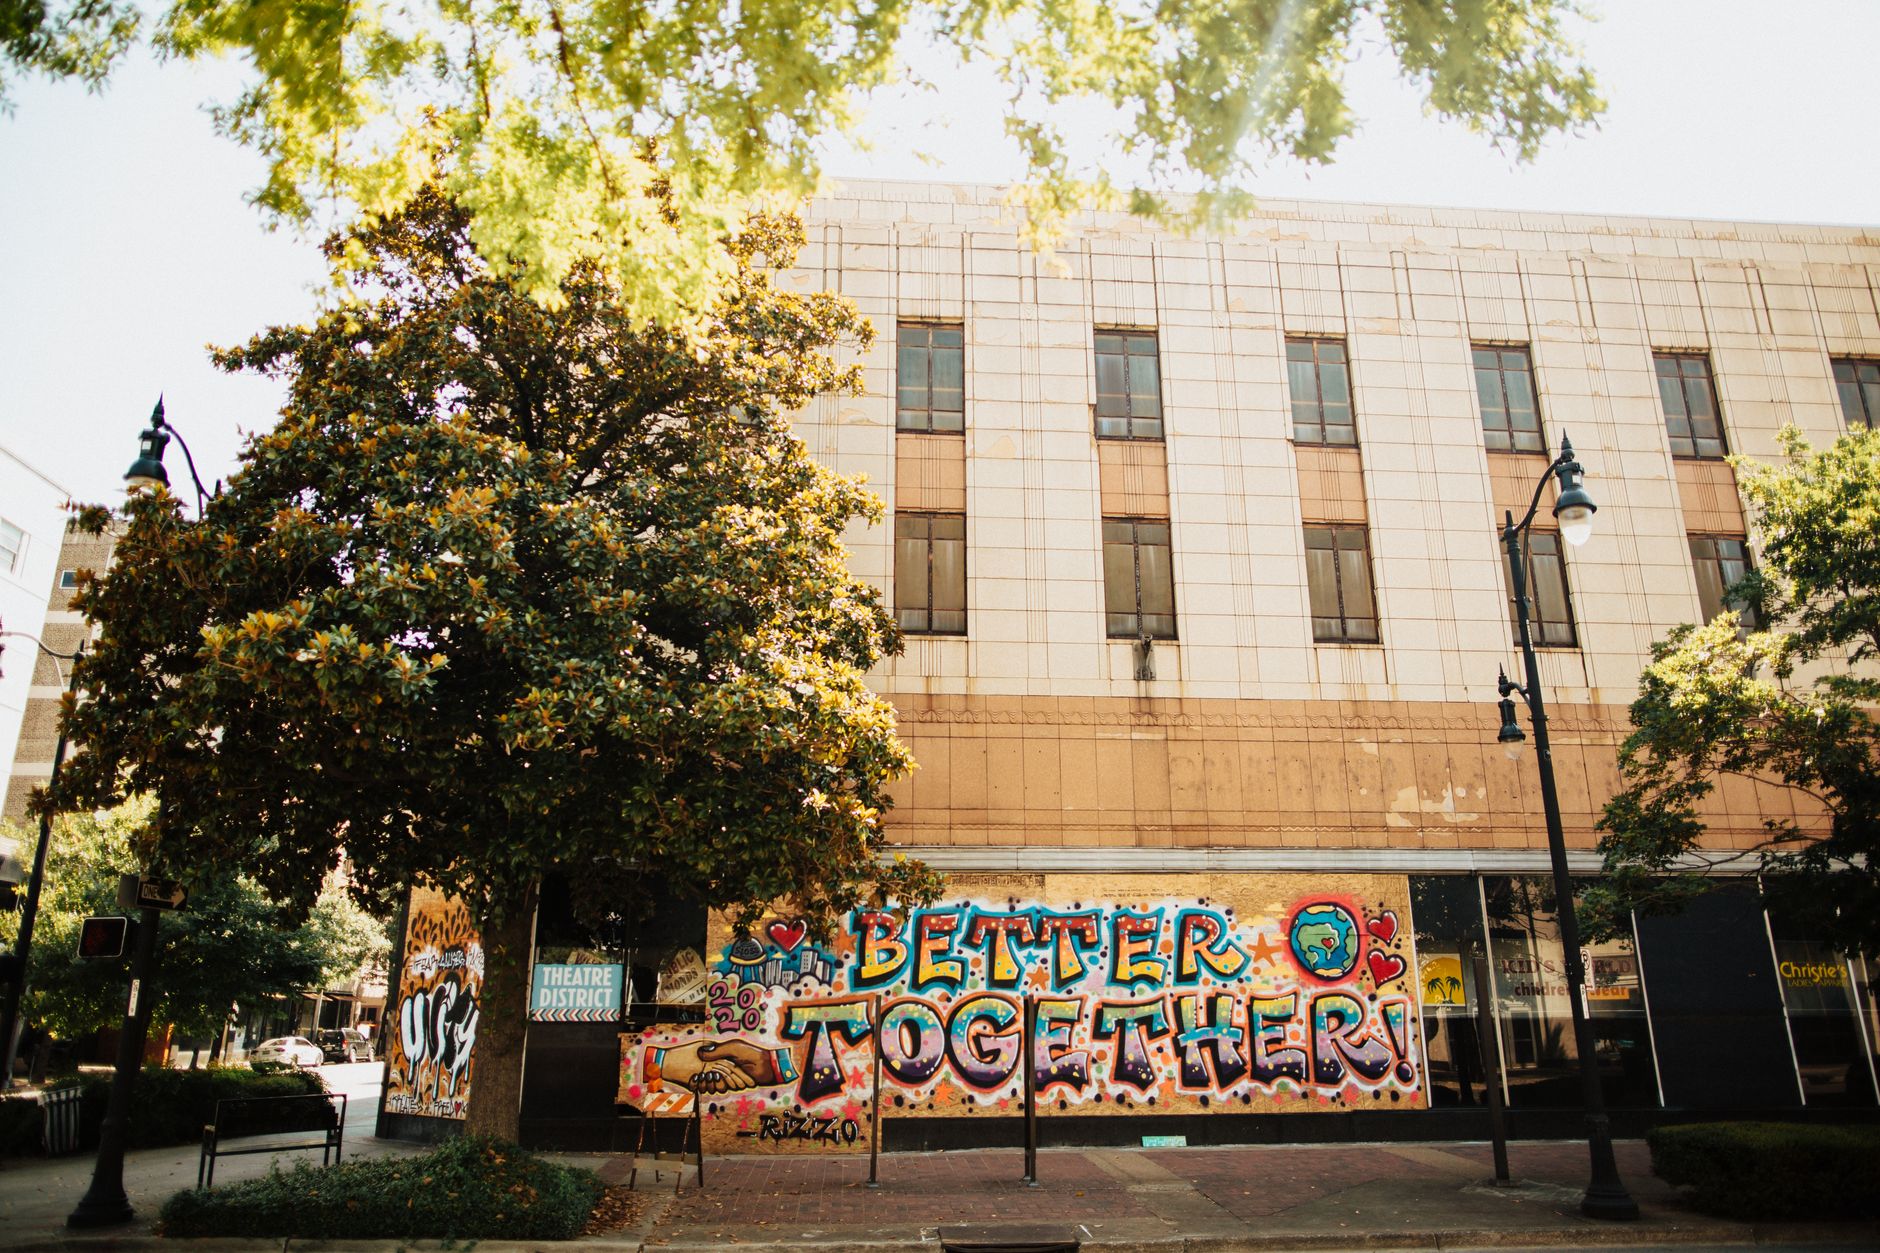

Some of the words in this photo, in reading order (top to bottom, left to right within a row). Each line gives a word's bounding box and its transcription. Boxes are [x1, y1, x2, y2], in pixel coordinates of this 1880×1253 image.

[143, 885, 158, 898] ONE
[852, 906, 1250, 992] BETTER
[542, 967, 612, 987] THEATRE
[1780, 961, 1848, 983] Christie's
[539, 988, 612, 1008] DISTRICT
[708, 981, 756, 1008] 20
[715, 1006, 762, 1034] 20
[788, 996, 1415, 1103] TOGETHER!
